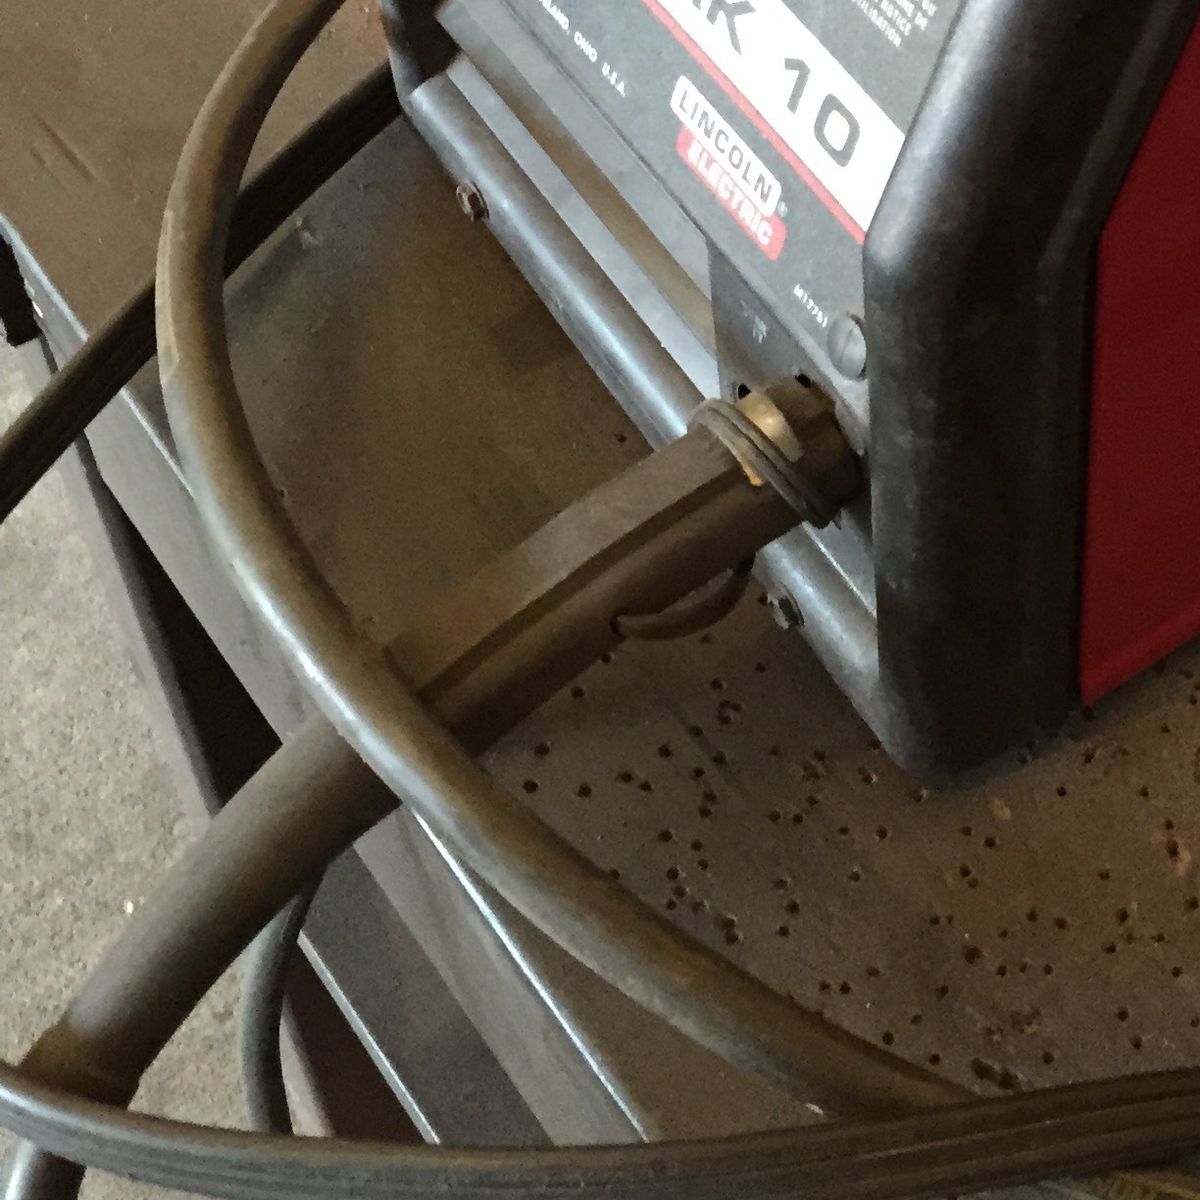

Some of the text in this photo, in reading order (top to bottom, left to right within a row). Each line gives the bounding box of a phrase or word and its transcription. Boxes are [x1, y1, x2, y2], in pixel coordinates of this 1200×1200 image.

[680, 90, 772, 204] LINCOLN
[784, 57, 861, 168] 10
[687, 140, 773, 246] ELECTRIC
